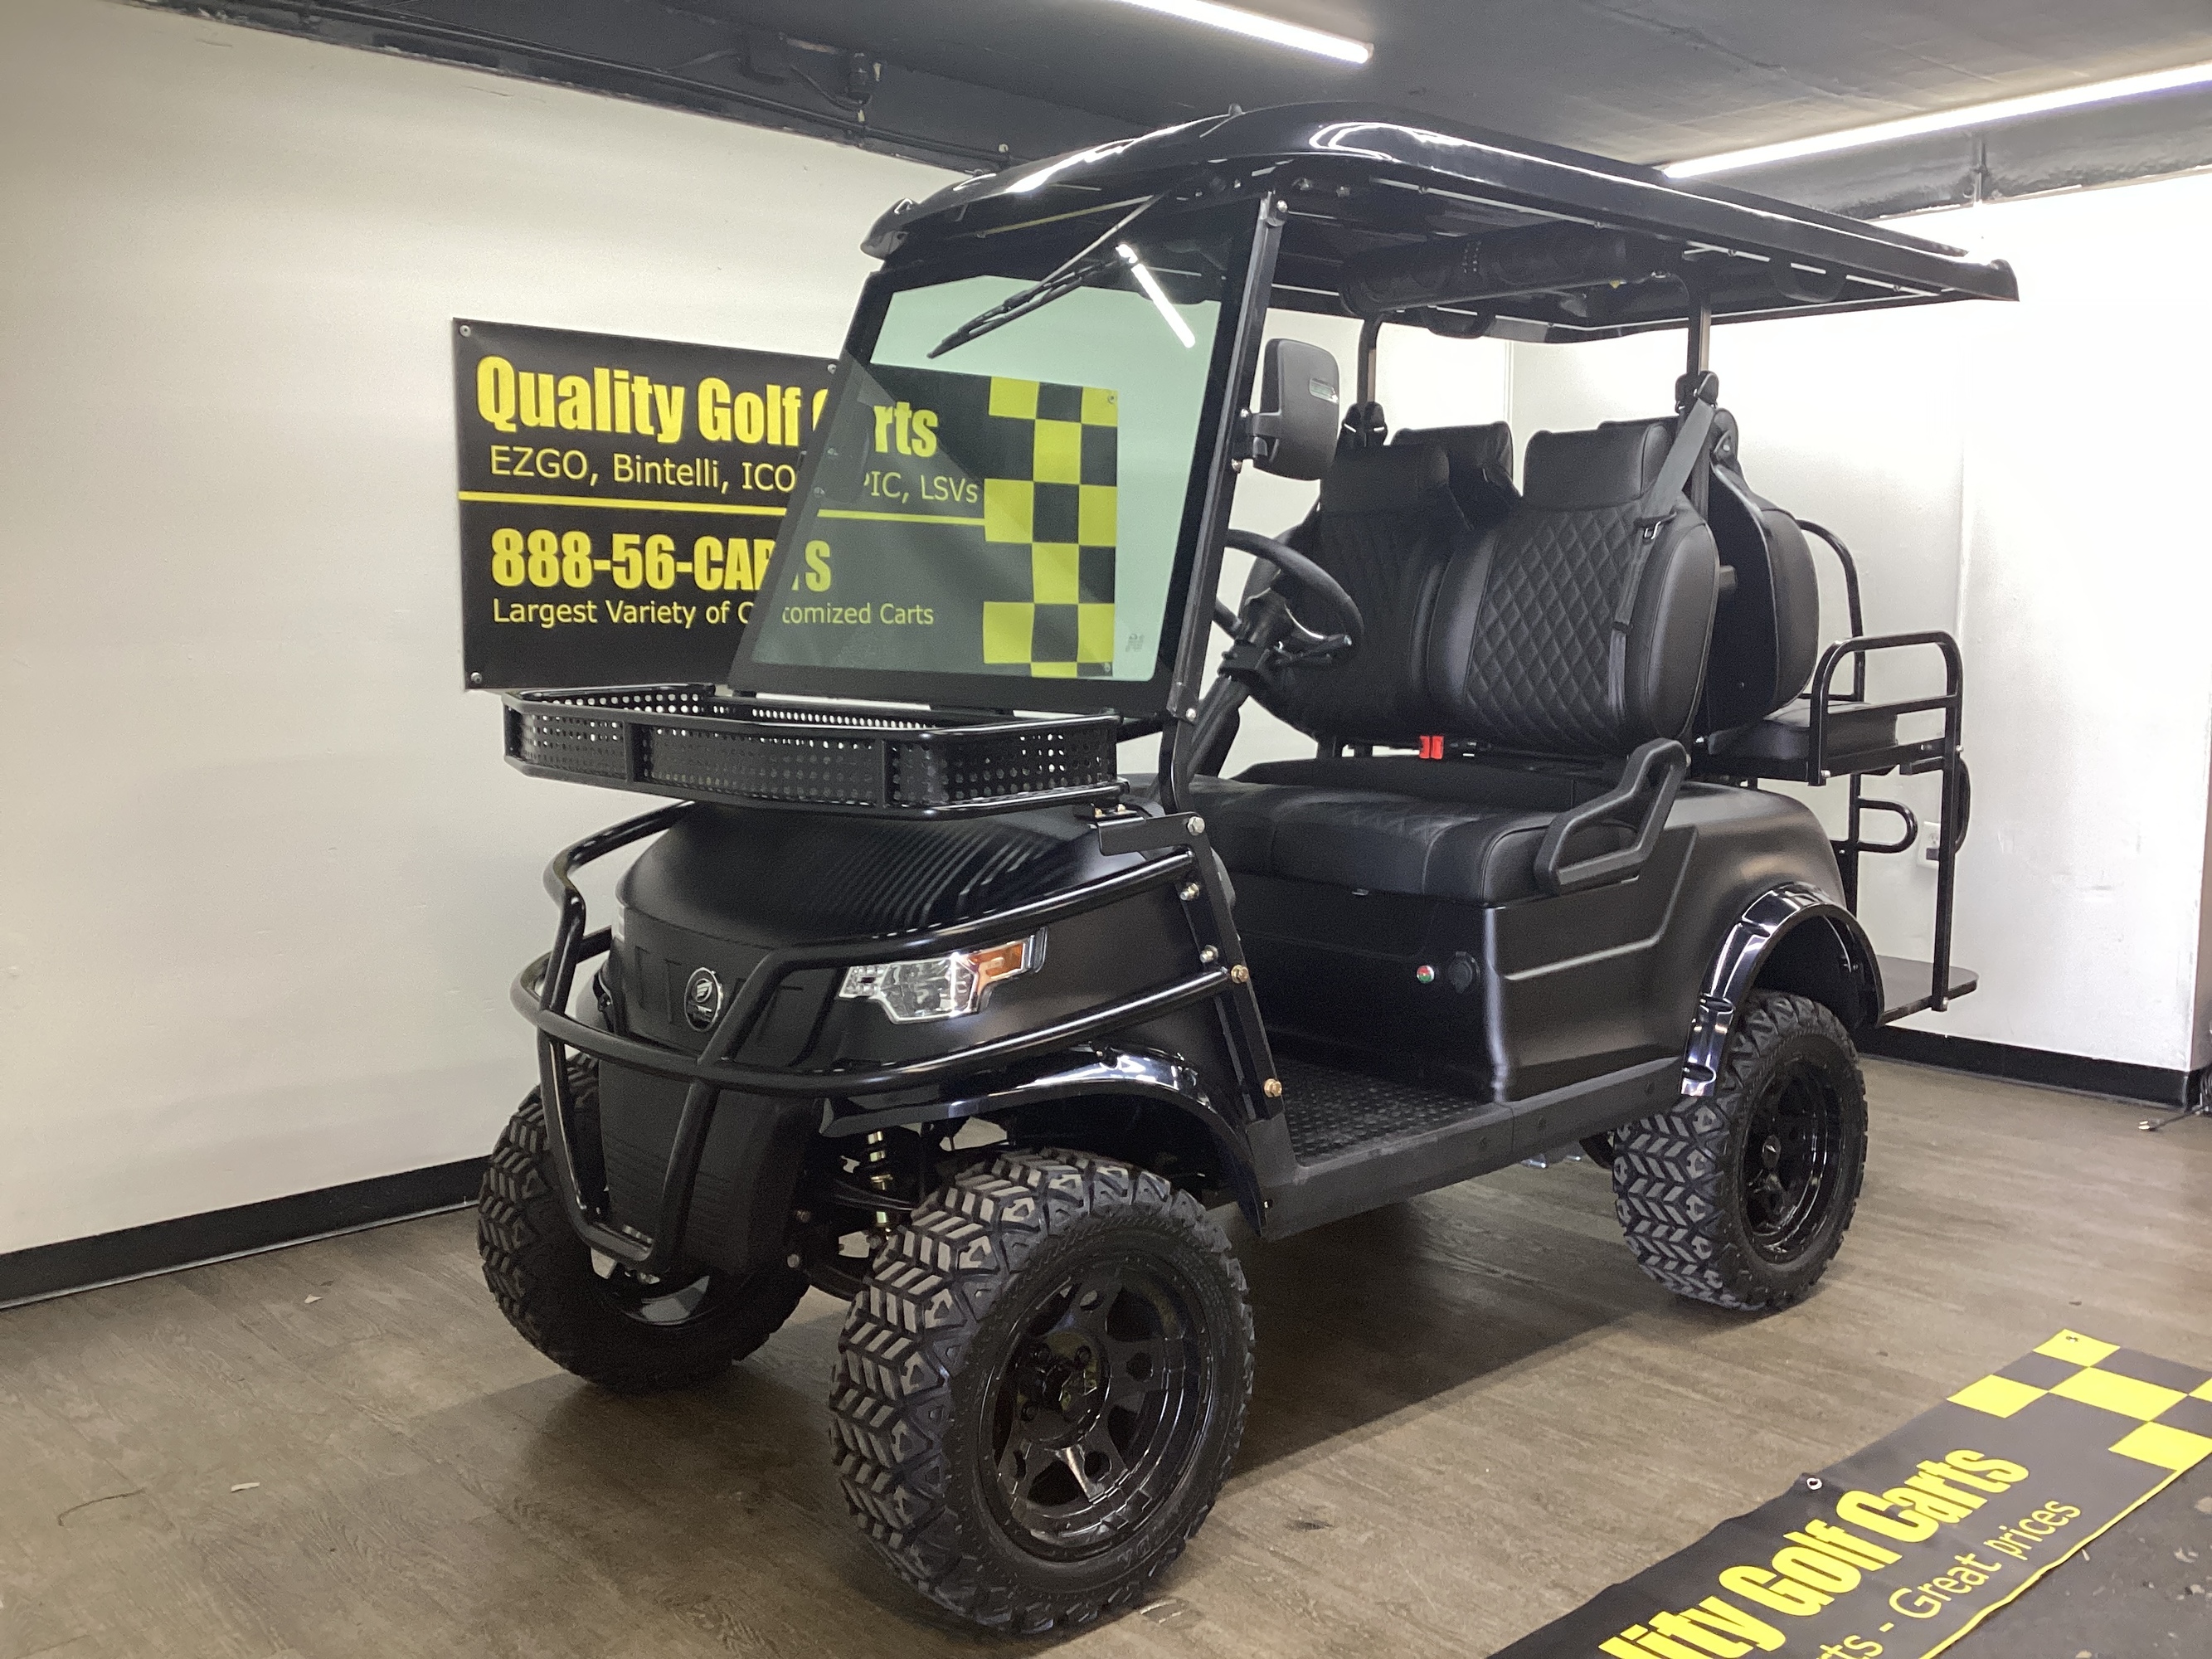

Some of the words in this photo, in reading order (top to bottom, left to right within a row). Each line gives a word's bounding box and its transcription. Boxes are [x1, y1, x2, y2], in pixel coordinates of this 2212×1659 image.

[476, 355, 685, 444] Quality
[698, 377, 802, 446] Golf
[490, 445, 599, 486] EZGO,
[613, 453, 728, 494] Bintelli,
[741, 462, 796, 492] ICO
[863, 470, 909, 504] IC,
[920, 474, 979, 504] LSVs
[491, 528, 832, 592] 888-56-CARS
[493, 598, 598, 629] Largest
[605, 600, 697, 630] Variety
[705, 600, 731, 624] of
[879, 603, 935, 625] Carts
[1597, 1596, 1787, 1659] lity
[1719, 1519, 1903, 1618] Golf
[1836, 1449, 2030, 1543] Carts
[1889, 1552, 2002, 1618] Great
[1982, 1500, 2082, 1562] prices
